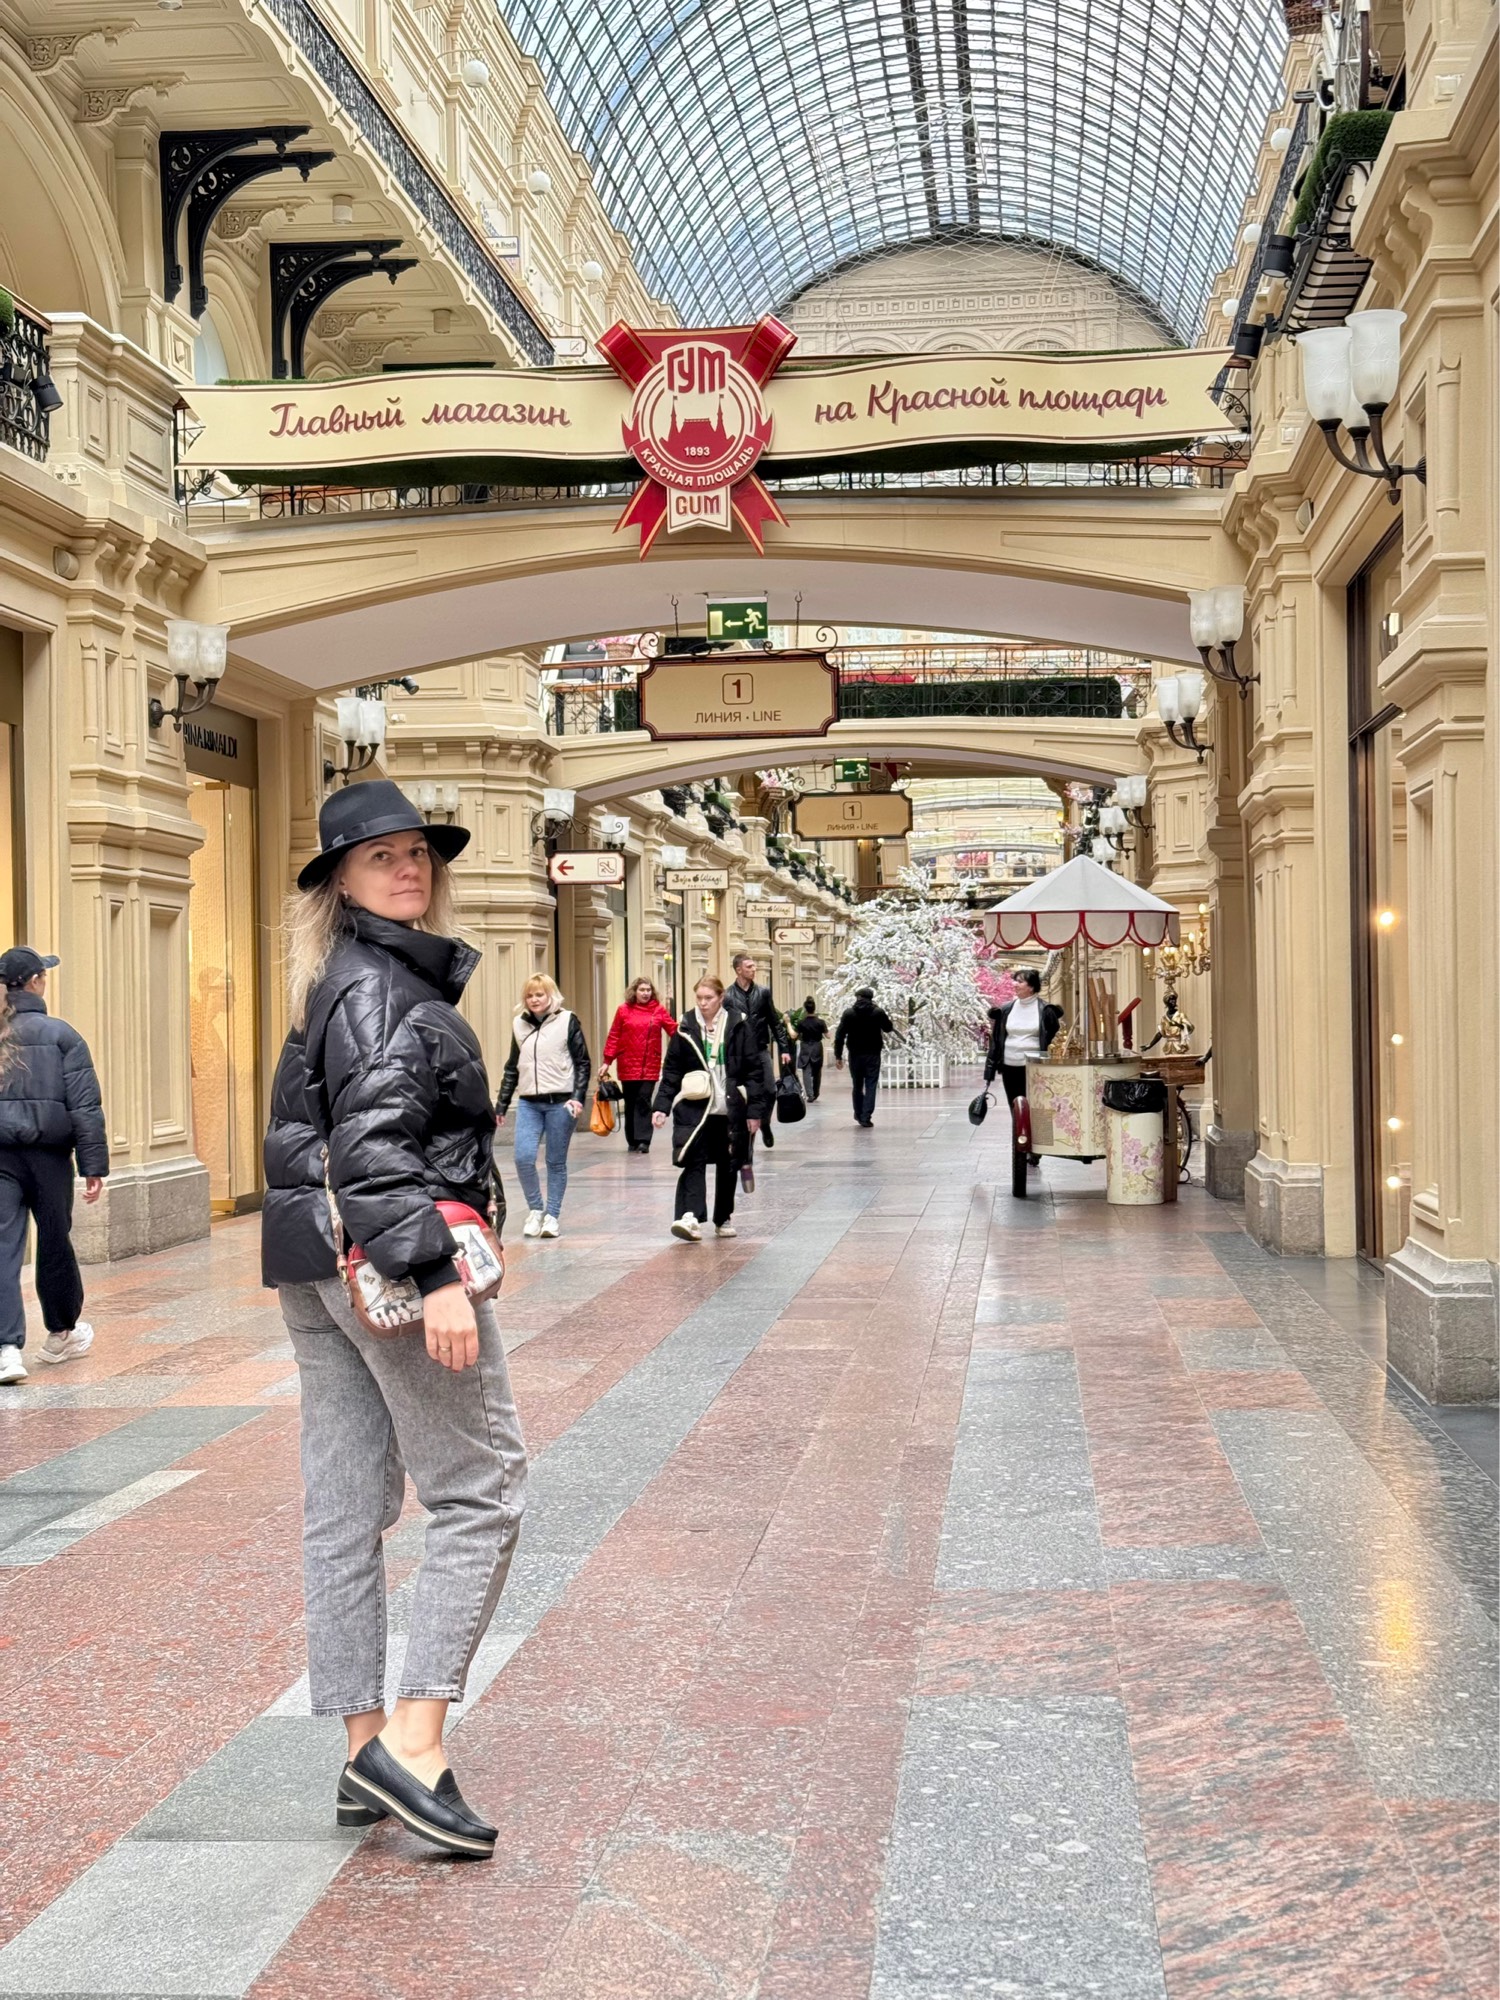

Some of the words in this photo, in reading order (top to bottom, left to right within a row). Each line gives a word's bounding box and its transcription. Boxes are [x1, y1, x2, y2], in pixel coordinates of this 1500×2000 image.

[667, 346, 726, 394] ГУМ
[814, 400, 857, 425] на
[866, 376, 1012, 425] Красной
[1017, 384, 1169, 419] площади
[268, 396, 406, 438] Главный
[421, 400, 572, 428] магазин
[683, 446, 711, 457] 1893
[639, 447, 694, 487] КРАСНАЯ
[696, 445, 756, 487] ПЛОЩАДЬ
[675, 494, 722, 516] GUM
[731, 678, 743, 699] 1
[694, 711, 743, 725] ЛИНИЯ
[752, 710, 782, 723] LINE
[848, 804, 855, 817] 1
[826, 823, 855, 832] ЛИНИЯ
[861, 822, 880, 831] LINE
